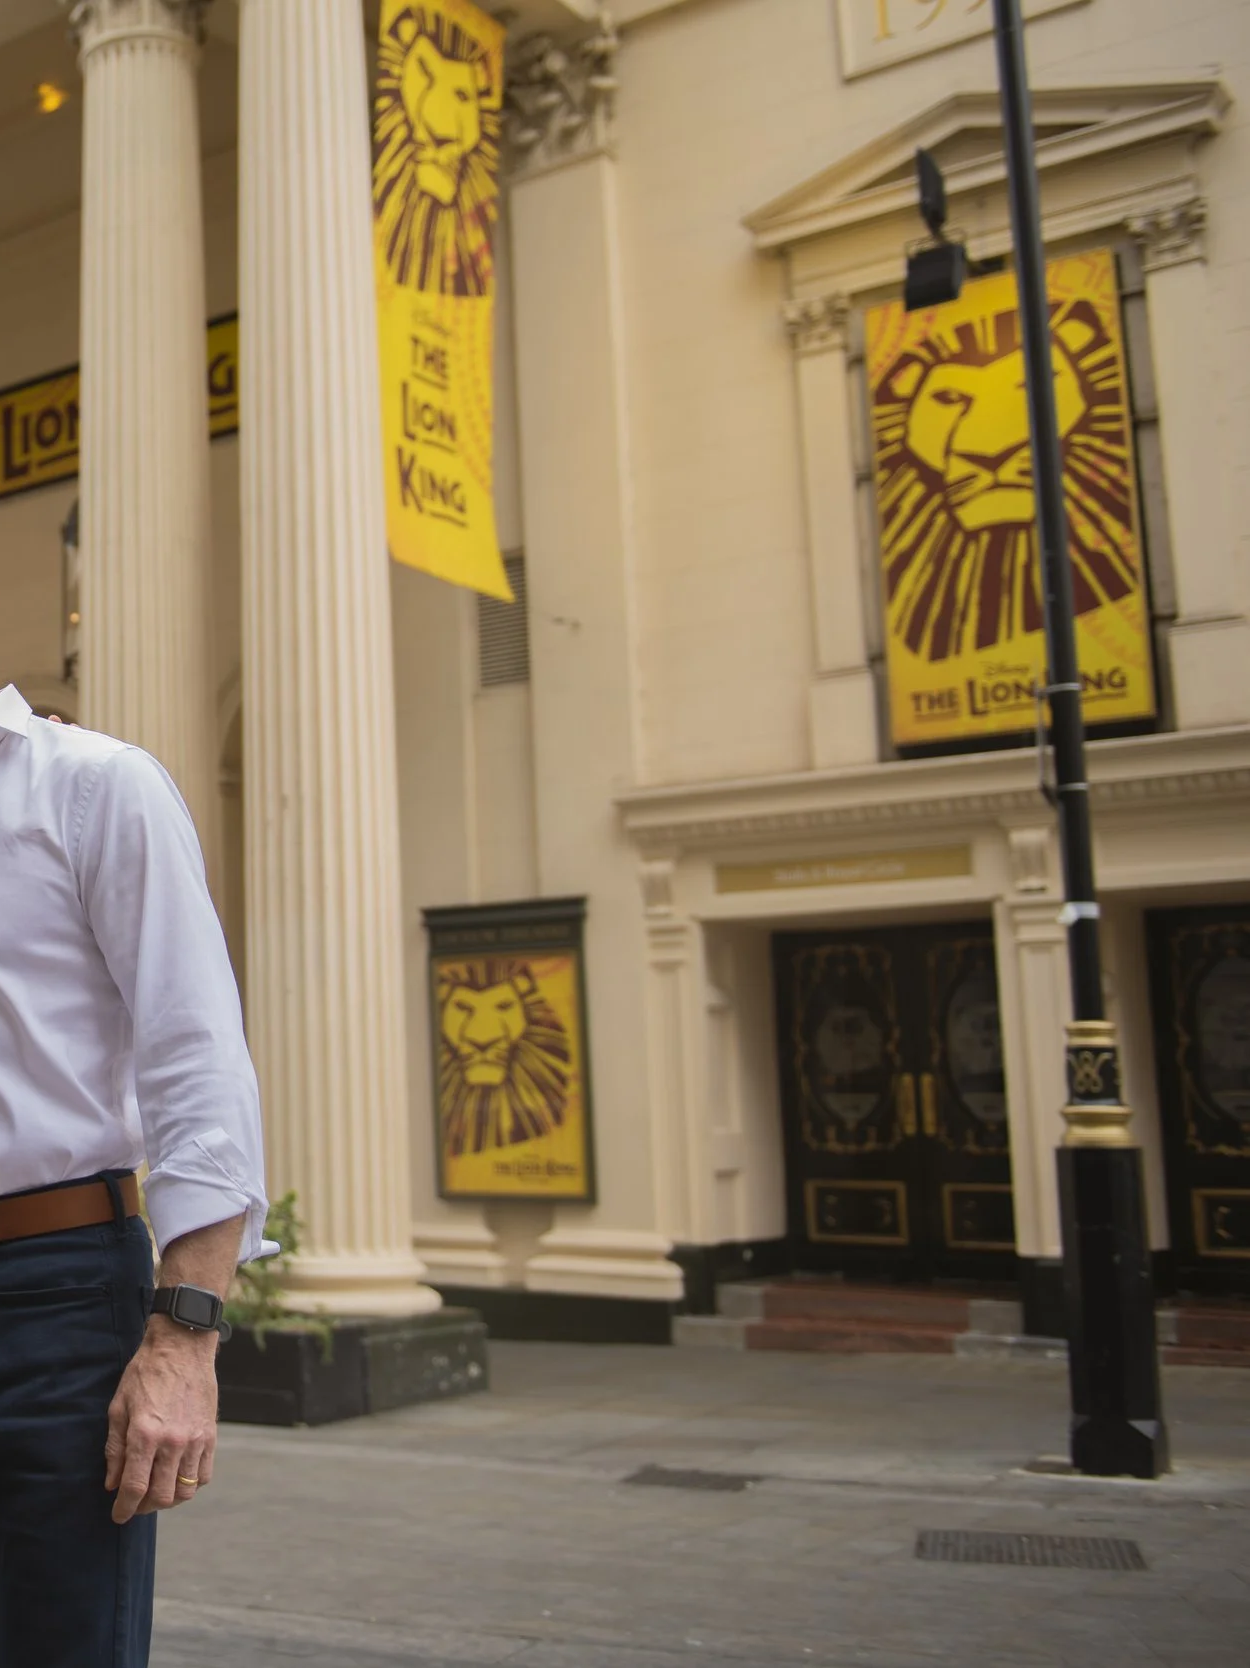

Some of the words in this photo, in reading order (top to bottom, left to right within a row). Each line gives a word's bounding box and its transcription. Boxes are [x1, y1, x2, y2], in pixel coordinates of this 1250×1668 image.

[411, 334, 449, 379] THE
[402, 381, 456, 442] LION
[396, 445, 466, 515] KING
[911, 689, 958, 713] THE
[966, 676, 1038, 717] LION
